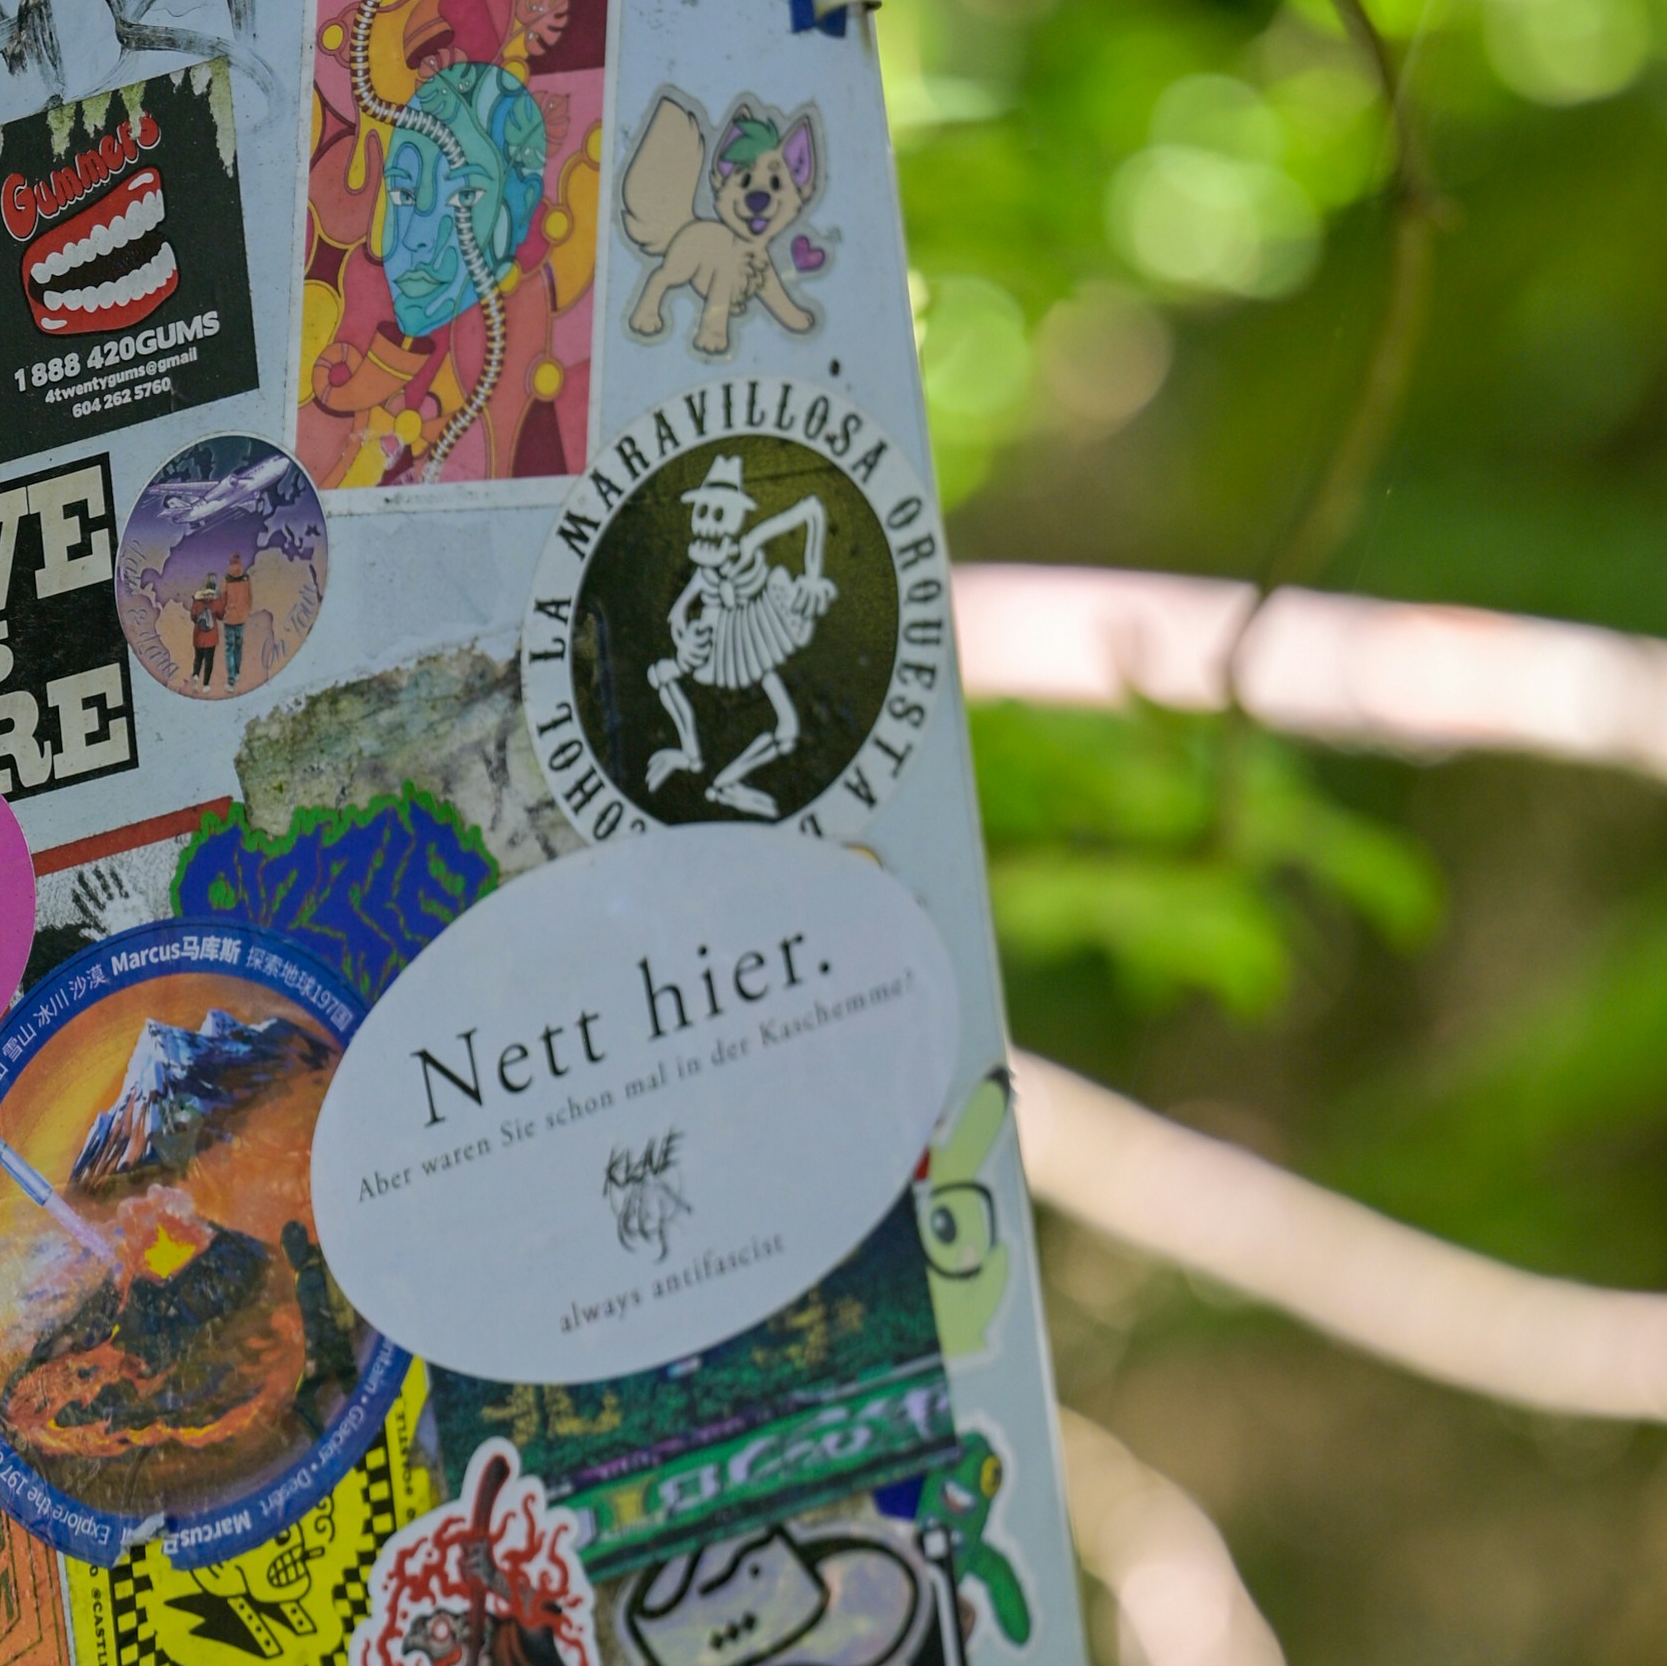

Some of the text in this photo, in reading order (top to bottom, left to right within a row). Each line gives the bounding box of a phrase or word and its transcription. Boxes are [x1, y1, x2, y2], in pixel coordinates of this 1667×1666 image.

[0, 111, 162, 240] Gummers
[13, 310, 221, 393] 1 888 420GUMS
[44, 347, 199, 405] 4twentygums@gmail
[71, 377, 173, 420] 604 262 5760
[528, 380, 945, 809] LA MARAVILLOSA ORQUESTA
[2, 1026, 38, 1063] 雪山
[34, 992, 70, 1028] 冰川
[68, 966, 107, 1002] 沙漠
[412, 931, 833, 1129] Nett hier.
[357, 969, 918, 1204] Aber waren Sie schon mal in der Kaschemme?
[559, 1235, 786, 1334] always antifascist
[0, 1461, 29, 1495] 197
[24, 1485, 52, 1515] the
[265, 1469, 313, 1518] Desert
[319, 1404, 365, 1466] Glacier
[52, 1503, 112, 1545] Explore
